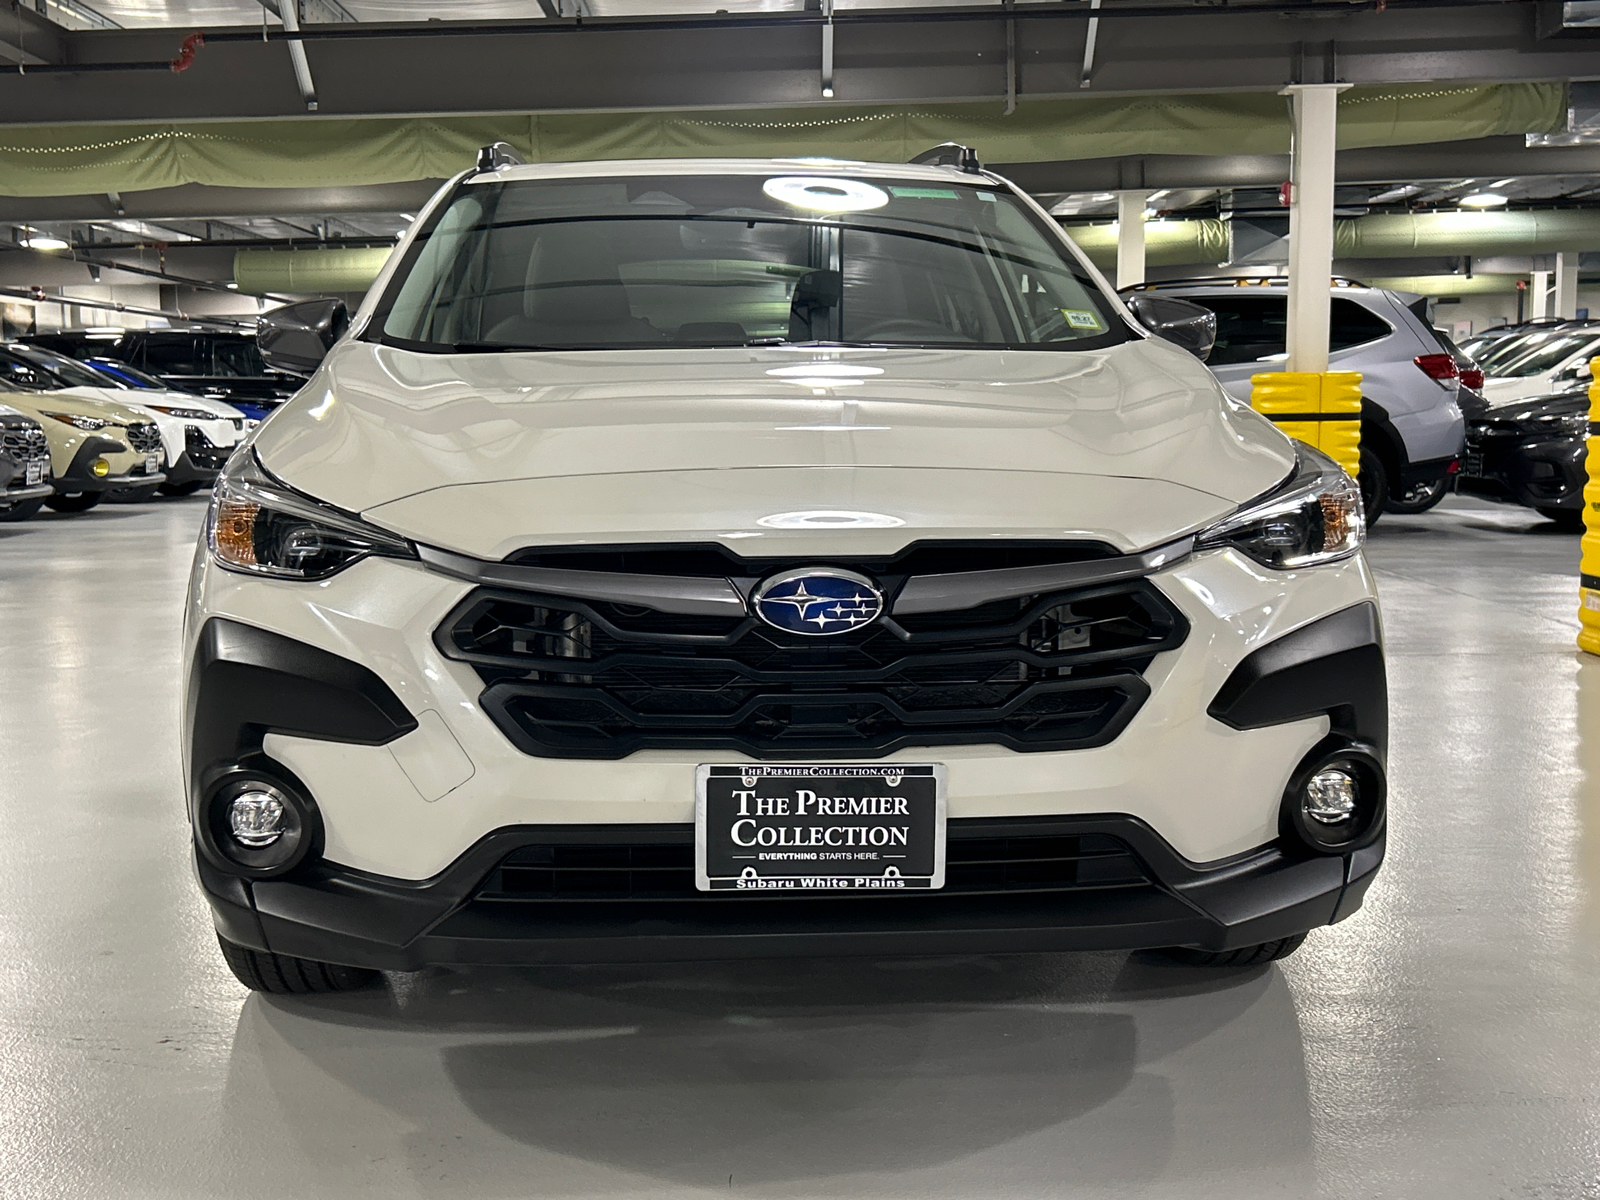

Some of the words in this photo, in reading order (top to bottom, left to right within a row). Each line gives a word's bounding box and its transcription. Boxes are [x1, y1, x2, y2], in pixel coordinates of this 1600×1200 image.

[732, 790, 790, 816] THE
[795, 790, 910, 815] PREMIER
[731, 819, 909, 847] COLLECTION
[758, 852, 817, 861] EVERYTHING
[819, 852, 852, 860] STARTS
[854, 851, 880, 860] HERE.
[736, 879, 794, 889] Subaru
[801, 878, 848, 888] White
[855, 878, 905, 888] Plains
